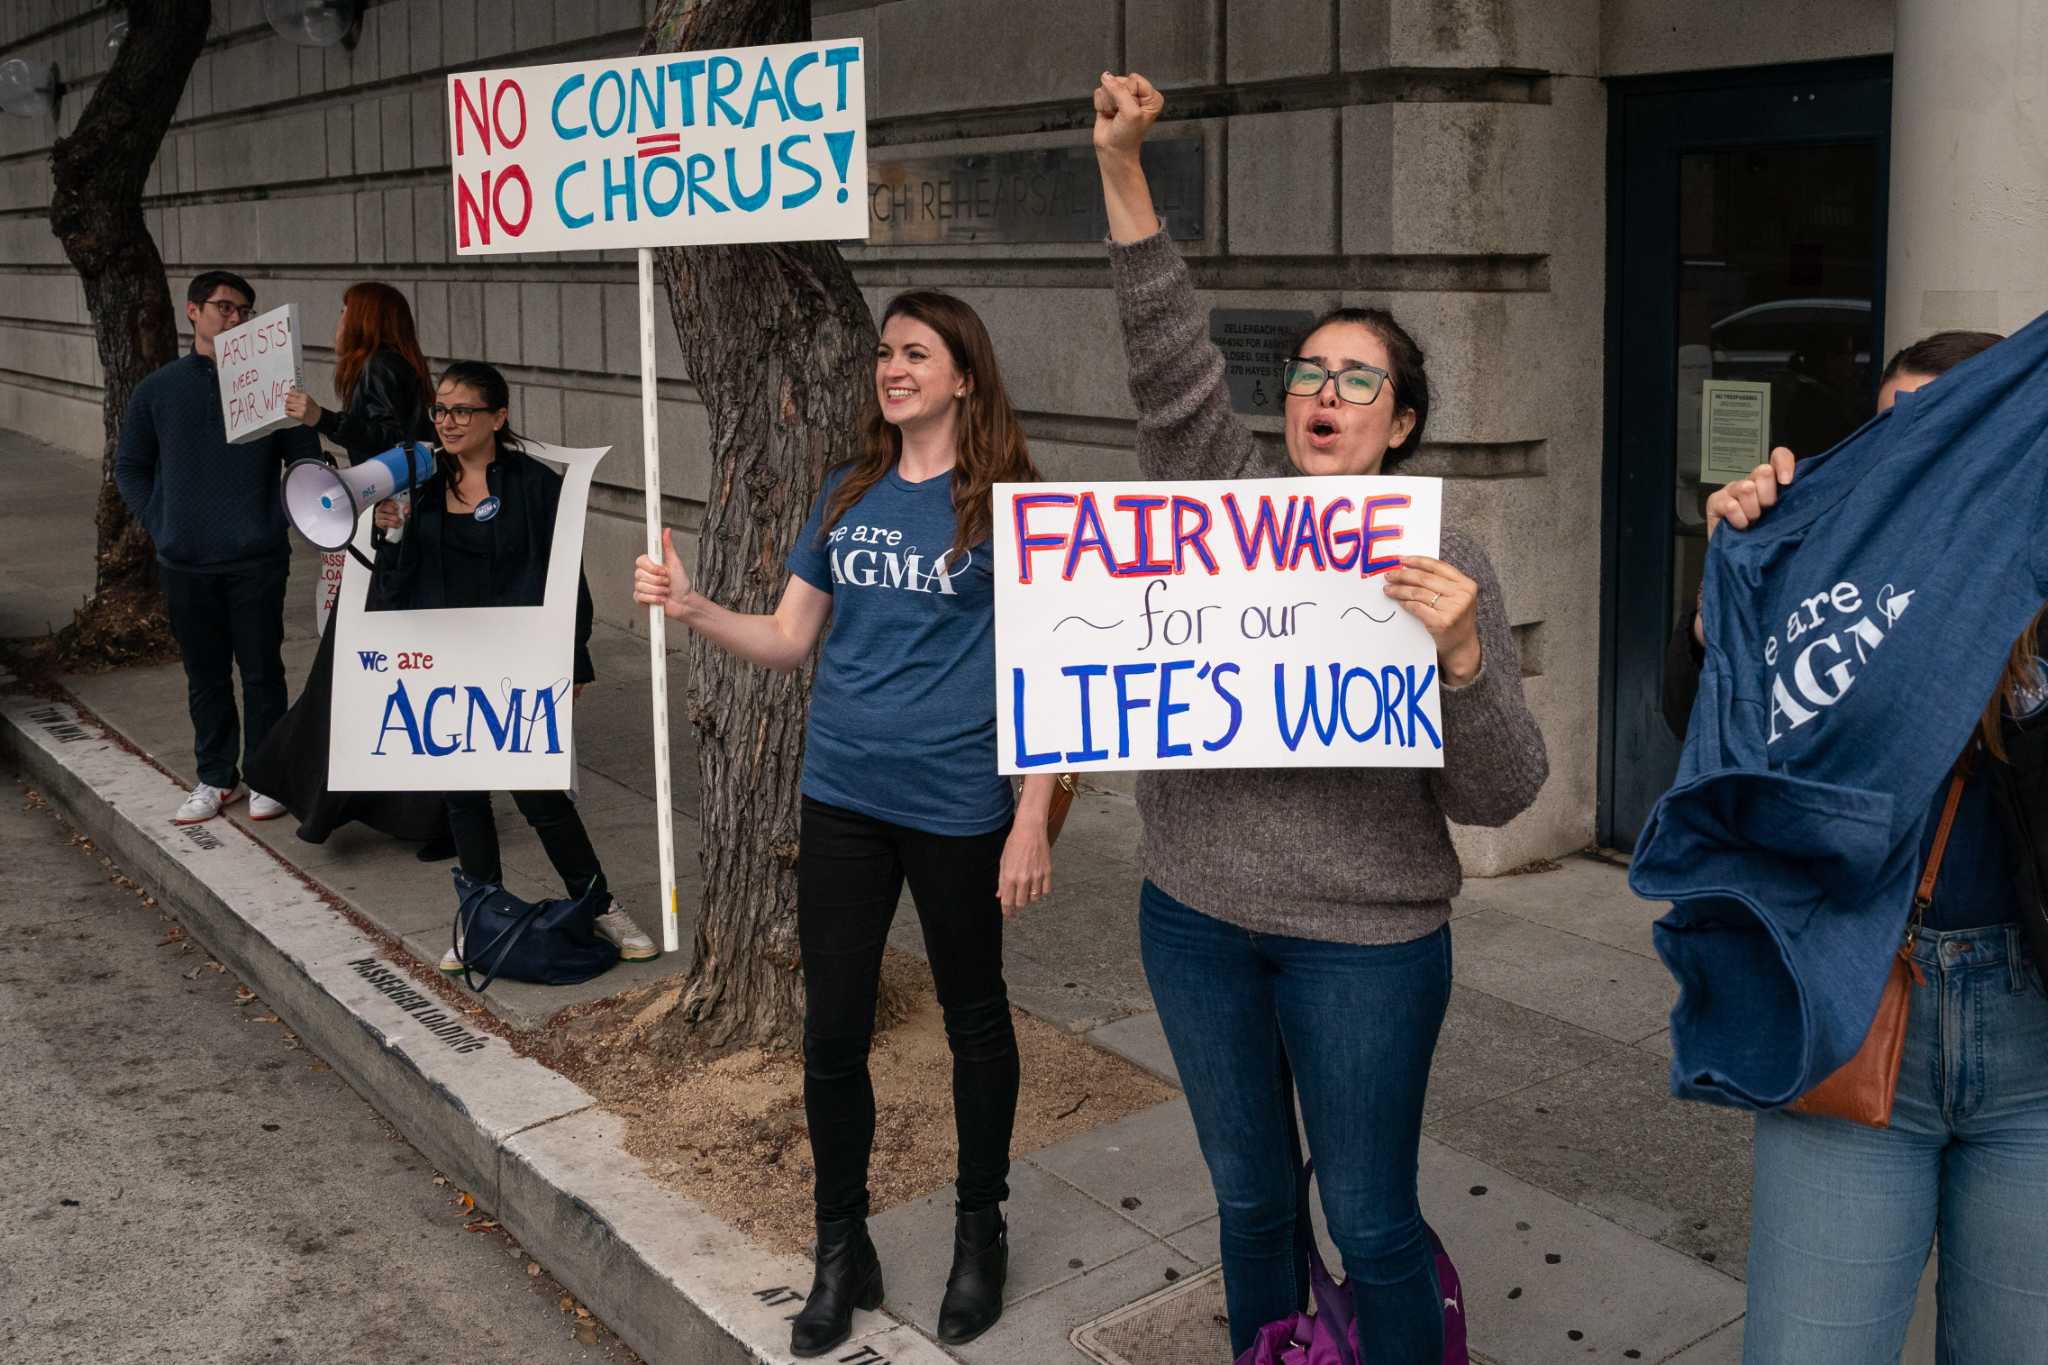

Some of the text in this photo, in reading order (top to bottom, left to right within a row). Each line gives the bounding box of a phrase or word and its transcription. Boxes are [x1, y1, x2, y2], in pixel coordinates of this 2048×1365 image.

[454, 46, 859, 156] NO CONTRACT
[457, 129, 856, 248] NO CHORUS!
[221, 321, 288, 368] ARTISTS
[229, 392, 263, 431] FAIR
[232, 369, 259, 394] NEED
[851, 525, 903, 546] are
[1012, 491, 1411, 585] FAIR WAGE
[1137, 579, 1318, 651] for our
[1764, 581, 1863, 666] e are
[357, 650, 434, 672] We are
[371, 677, 570, 757] AGMA
[1012, 660, 1442, 768] LIFE'S WORK
[347, 957, 486, 1054] PASSENGER LOADING
[752, 1286, 805, 1306] AT
[838, 1345, 891, 1365] TI
